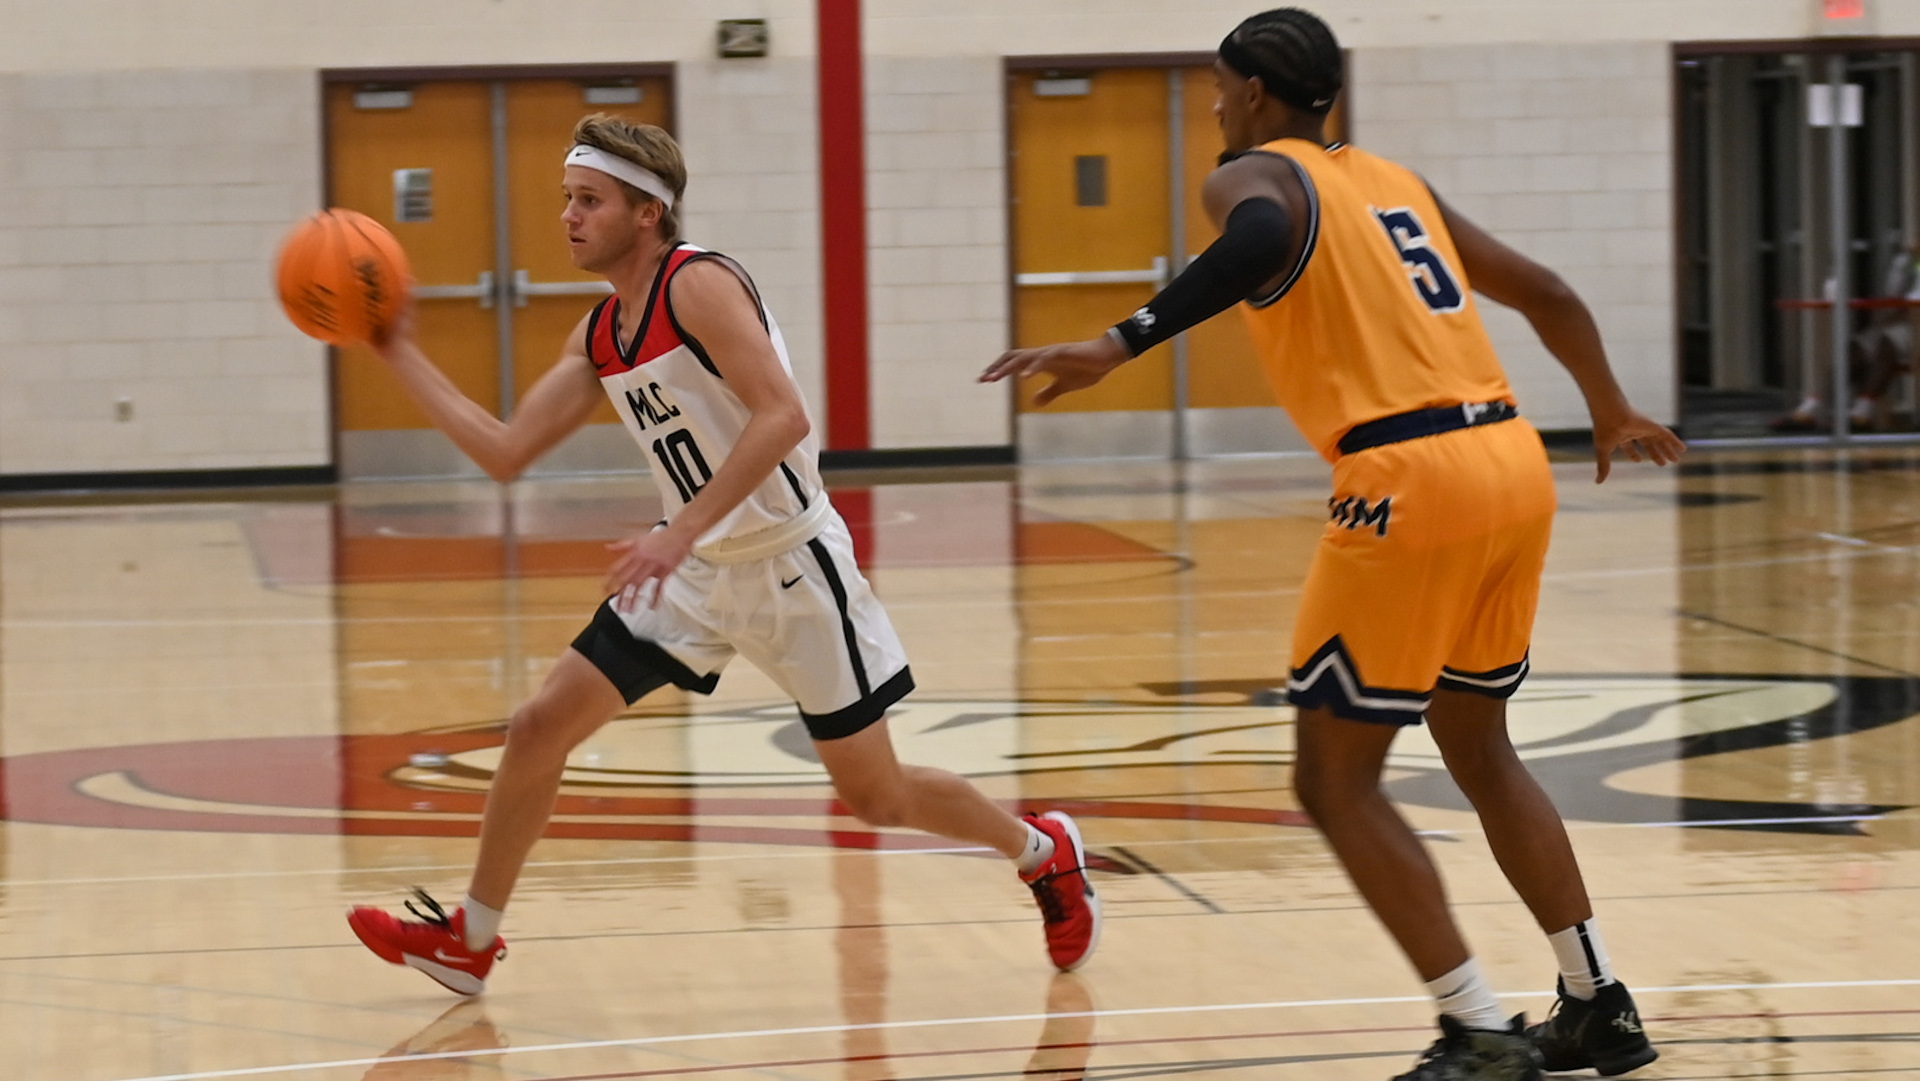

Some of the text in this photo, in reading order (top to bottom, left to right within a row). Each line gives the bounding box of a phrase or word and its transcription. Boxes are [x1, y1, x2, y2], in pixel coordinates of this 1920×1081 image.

[1367, 205, 1466, 315] 5
[625, 382, 681, 430] MLC
[652, 428, 713, 504] 10
